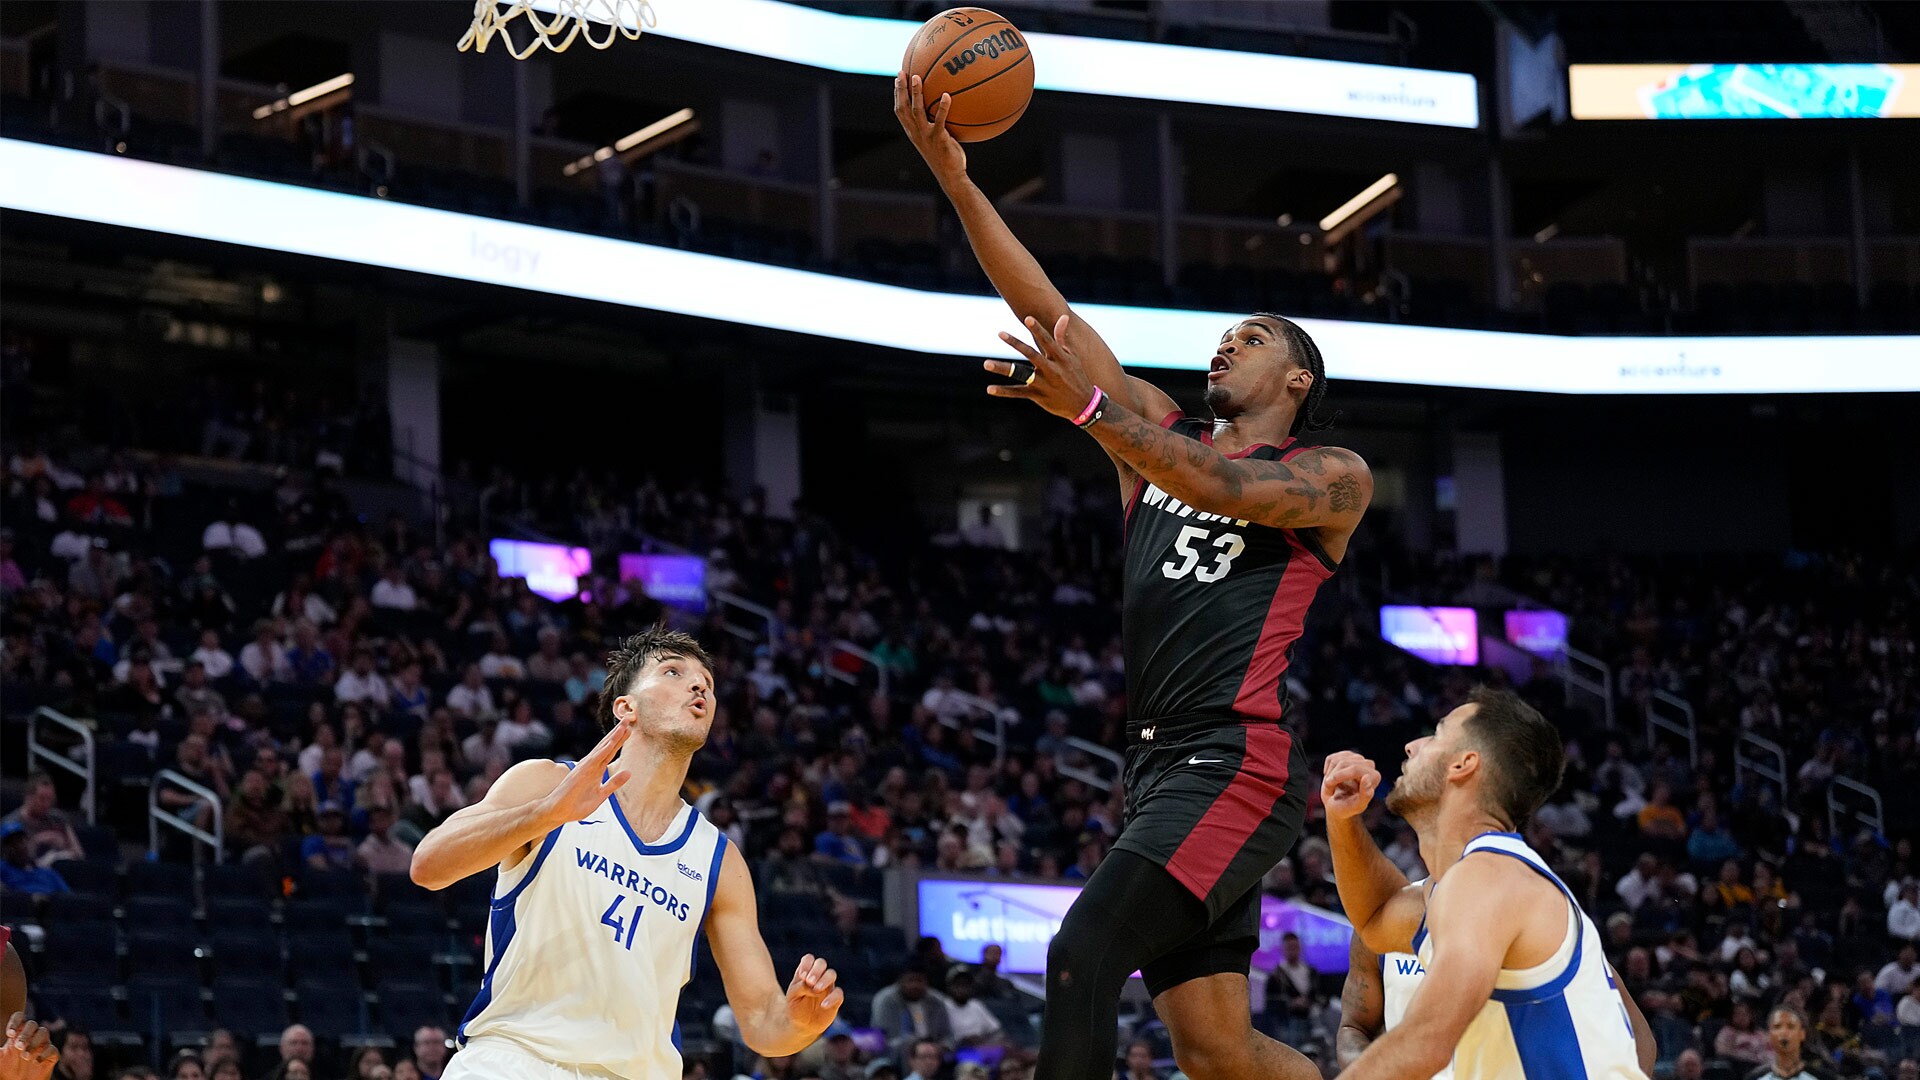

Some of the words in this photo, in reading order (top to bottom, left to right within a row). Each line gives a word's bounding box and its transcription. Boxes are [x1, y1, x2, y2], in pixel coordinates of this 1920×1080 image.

[943, 28, 1024, 76] Wilson
[470, 230, 541, 274] logy
[1161, 525, 1246, 584] 53
[575, 847, 690, 922] WARRIORS
[600, 894, 644, 951] 41
